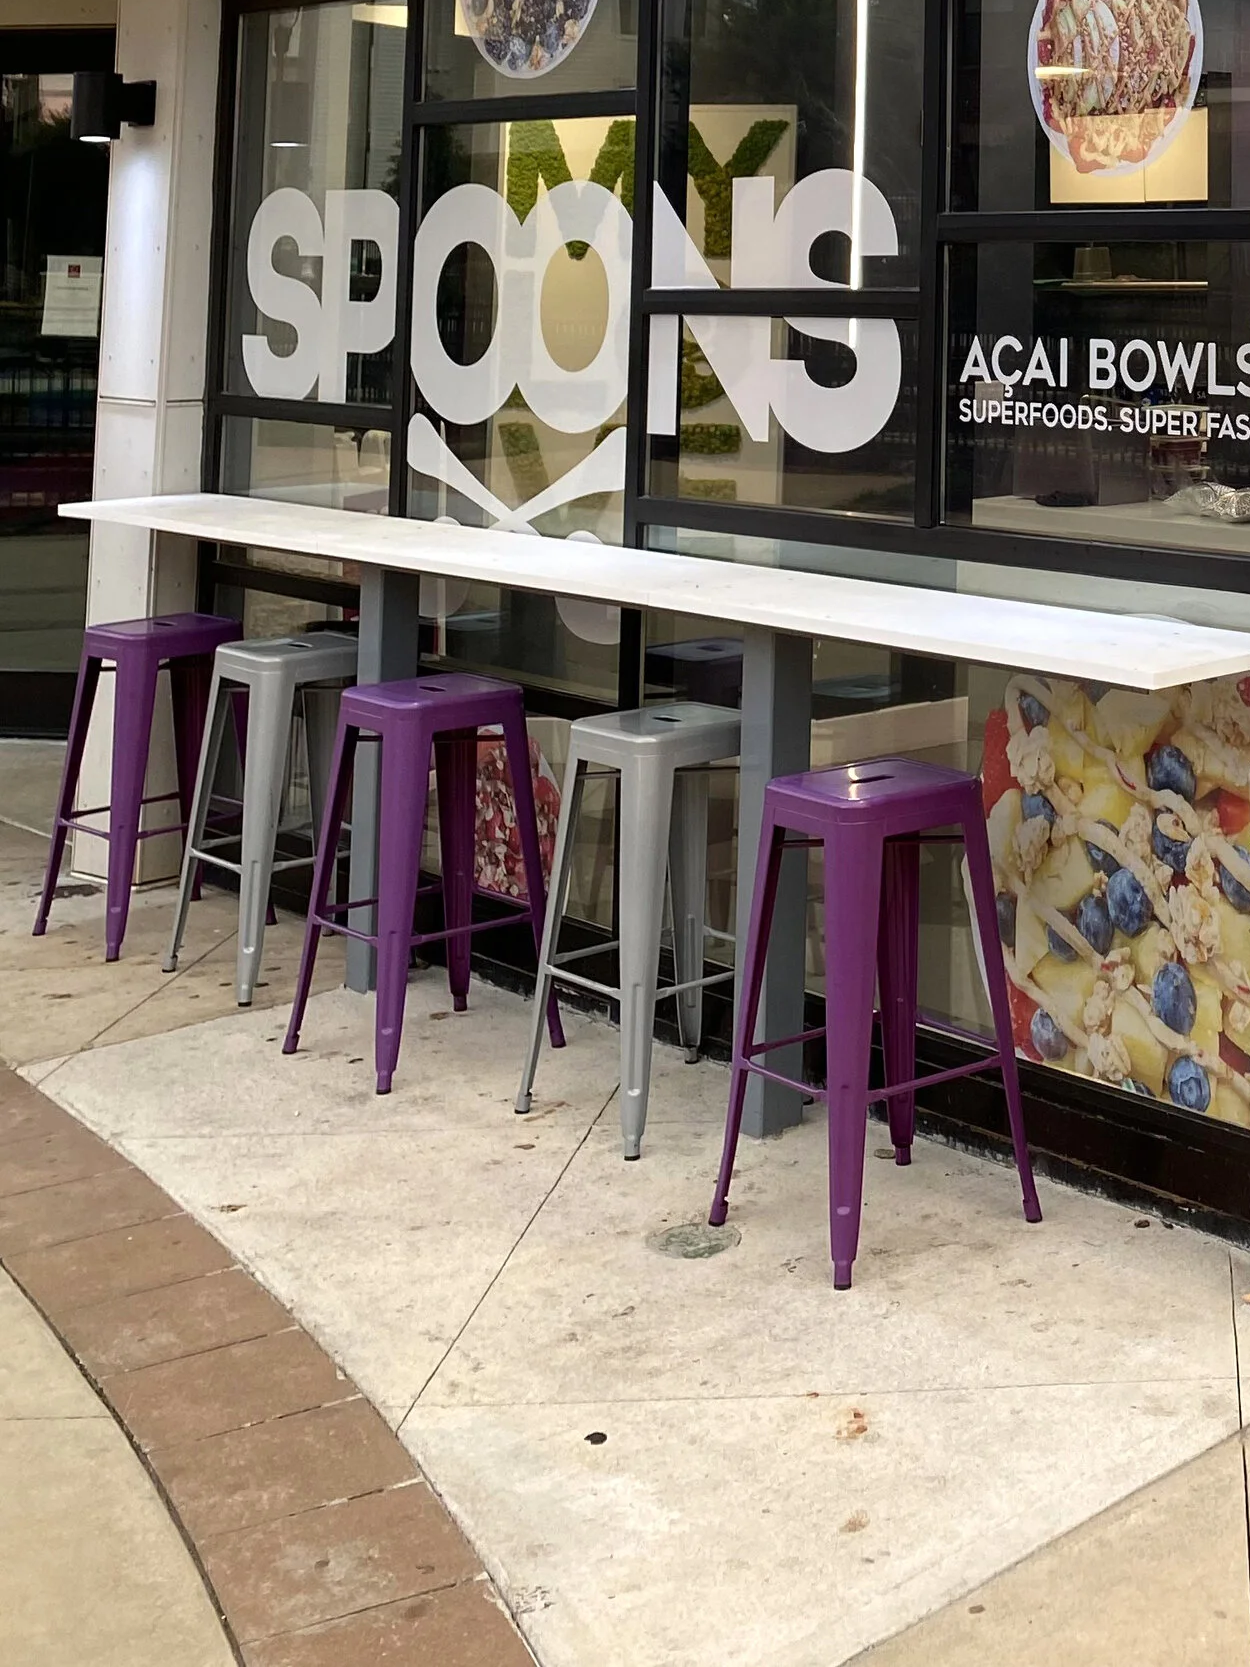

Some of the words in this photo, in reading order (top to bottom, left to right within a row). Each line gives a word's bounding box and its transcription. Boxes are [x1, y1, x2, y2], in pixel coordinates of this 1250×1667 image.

[241, 167, 903, 453] SPOONS
[959, 334, 1068, 398] AÇAI
[959, 398, 1113, 432] SUPERFOODS.
[1119, 407, 1199, 438] SUPER
